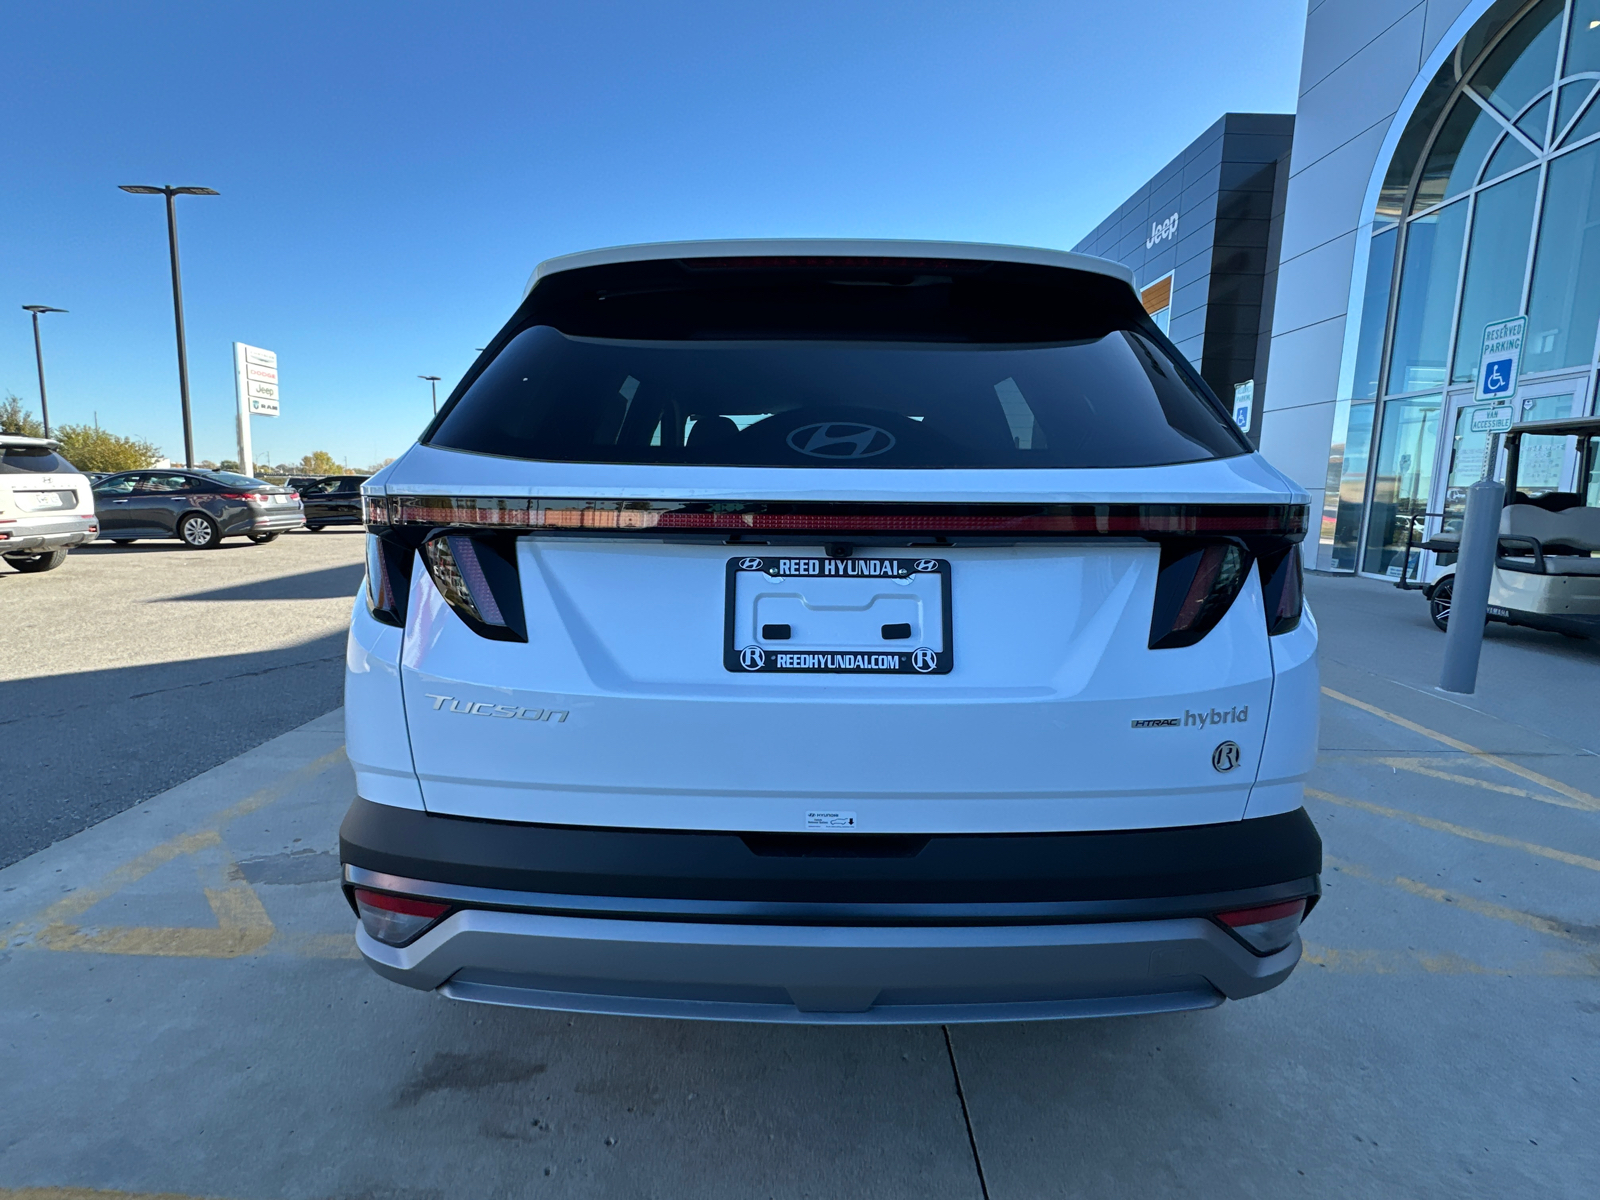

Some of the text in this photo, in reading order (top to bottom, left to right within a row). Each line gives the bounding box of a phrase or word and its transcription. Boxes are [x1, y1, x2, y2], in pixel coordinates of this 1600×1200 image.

[1146, 212, 1179, 250] Jeep
[1486, 324, 1522, 341] RESERVED
[1483, 338, 1520, 356] PARKING
[250, 369, 276, 379] DODGE
[256, 384, 274, 397] Jeep
[261, 403, 278, 411] RAM
[1486, 410, 1499, 419] VAN
[1472, 418, 1510, 430] ACCESSIBLE
[779, 559, 898, 576] REED HYUNDAI
[776, 653, 899, 670] REEDHYUNDAI.COM
[1135, 718, 1178, 727] HTRAC
[1183, 704, 1249, 730] hybrid
